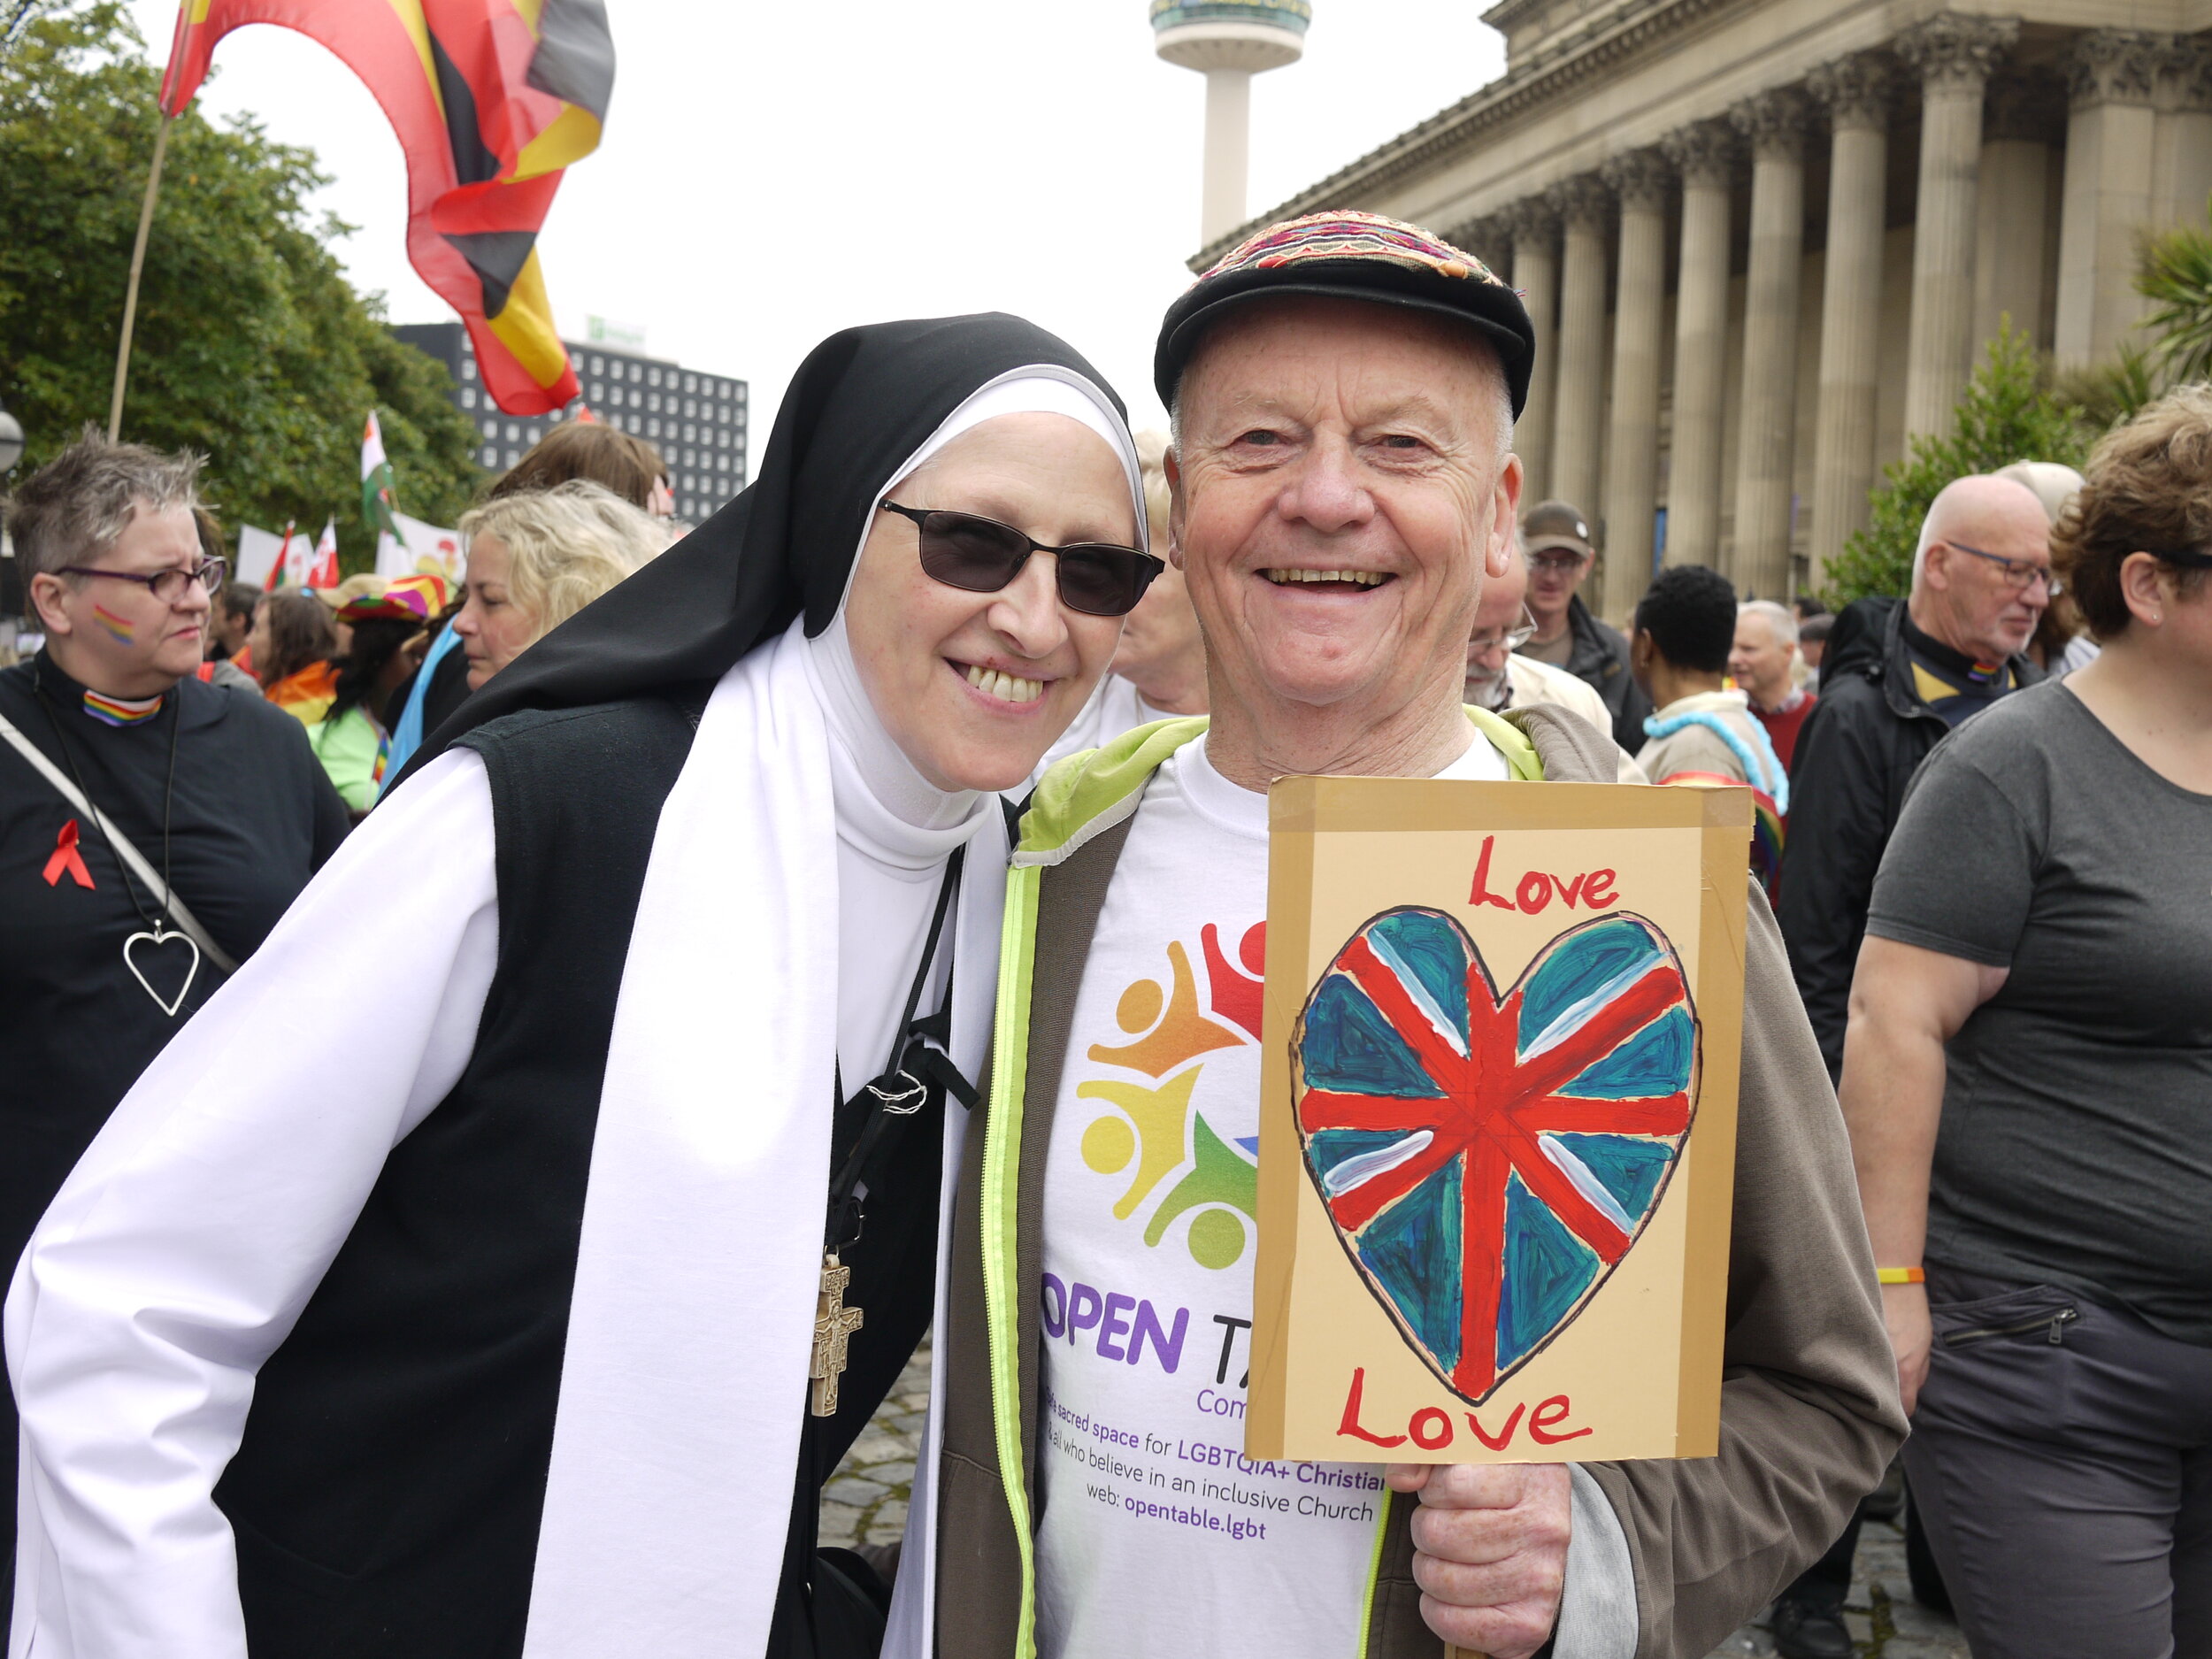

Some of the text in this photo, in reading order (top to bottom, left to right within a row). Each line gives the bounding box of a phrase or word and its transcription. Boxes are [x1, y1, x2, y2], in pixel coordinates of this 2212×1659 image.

[1468, 834, 1620, 915] Love
[1041, 1272, 1252, 1389] OPEN T
[1057, 1403, 1090, 1432] sacred
[1092, 1423, 1140, 1448] space
[1145, 1432, 1172, 1456] for
[1178, 1440, 1290, 1479] LGBTQIA+
[1336, 1367, 1594, 1452] Love
[1053, 1429, 1063, 1450] all
[1064, 1438, 1086, 1463] who
[1088, 1446, 1143, 1482] believe
[1149, 1467, 1165, 1488] in
[1171, 1477, 1195, 1494] an
[1202, 1479, 1290, 1512] inclusive
[1297, 1495, 1373, 1522] Church
[1087, 1483, 1267, 1540] web: opentable.lgbt
